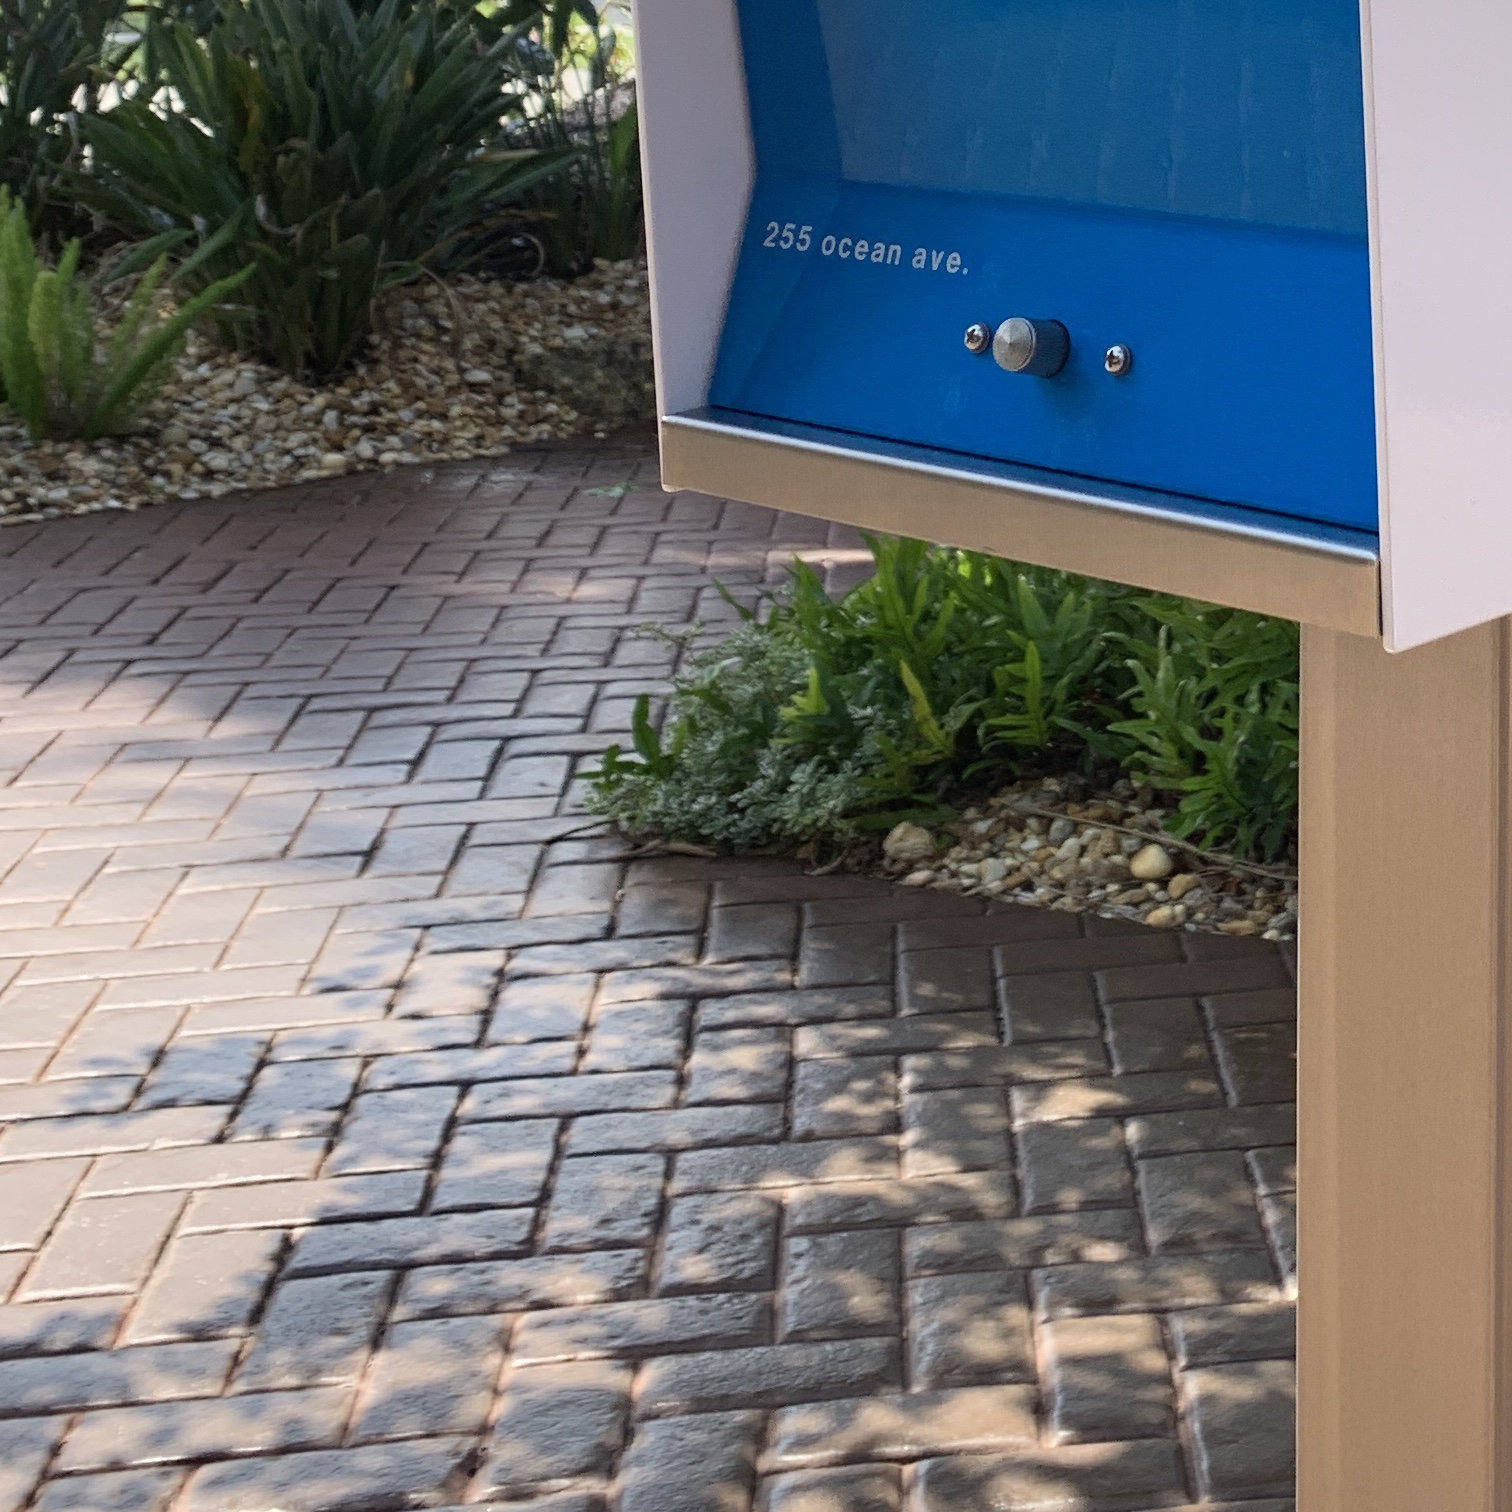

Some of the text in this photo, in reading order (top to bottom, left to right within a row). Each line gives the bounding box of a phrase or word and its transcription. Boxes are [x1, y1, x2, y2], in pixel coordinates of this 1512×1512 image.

[762, 220, 969, 276] 255 ocean ave.
